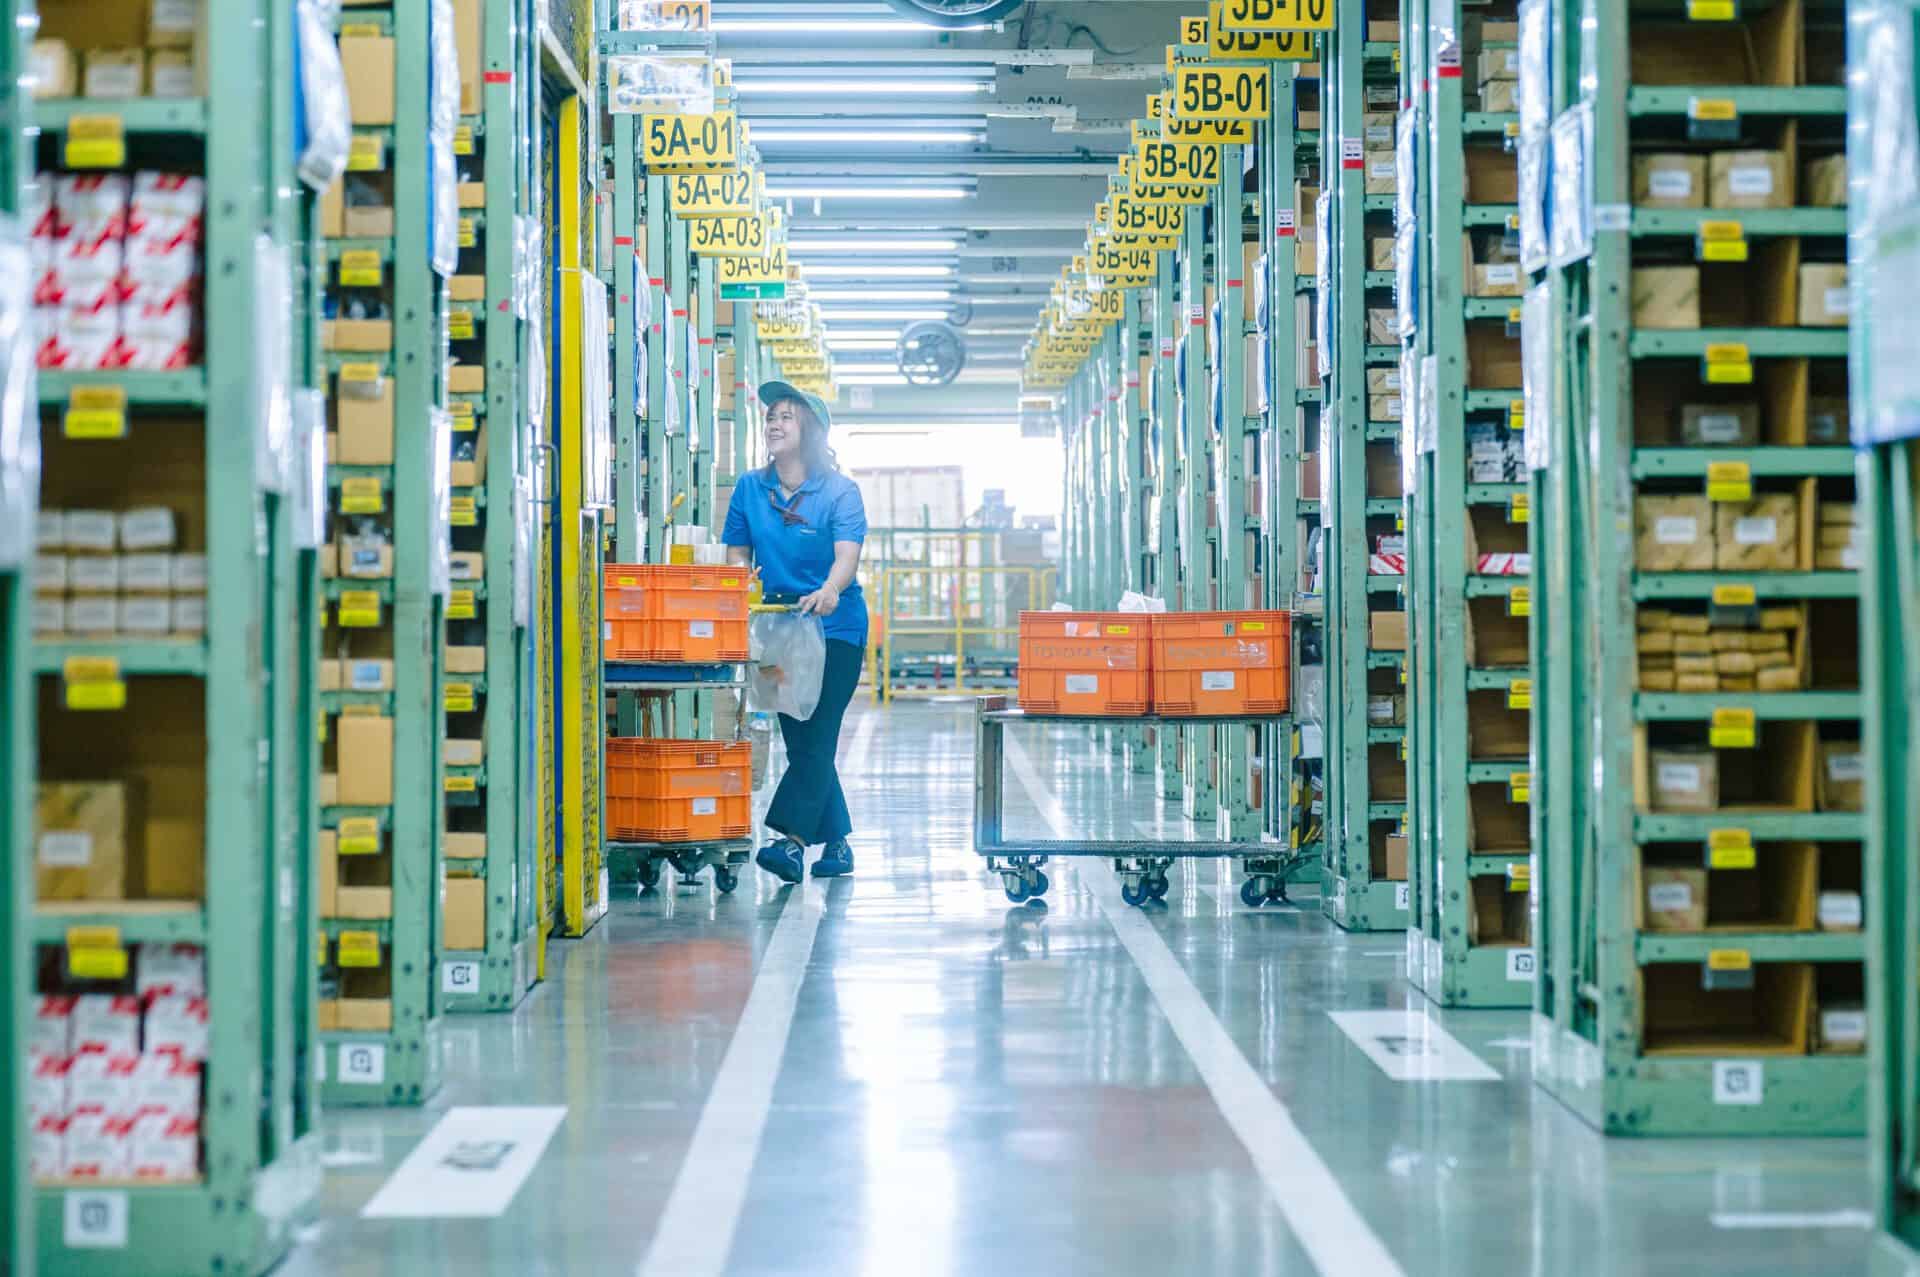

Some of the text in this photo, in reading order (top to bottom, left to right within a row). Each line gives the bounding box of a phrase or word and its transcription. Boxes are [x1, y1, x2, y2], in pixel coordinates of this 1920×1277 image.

[1184, 73, 1266, 112] 5B-01
[651, 117, 733, 156] 5A-01
[1145, 144, 1217, 179] 5B-02
[677, 171, 750, 205] 5A-02
[1118, 199, 1181, 229] 5B-03
[696, 217, 761, 246] 5A-03
[725, 248, 783, 276] 5A-04
[1097, 243, 1150, 269] 5B-04
